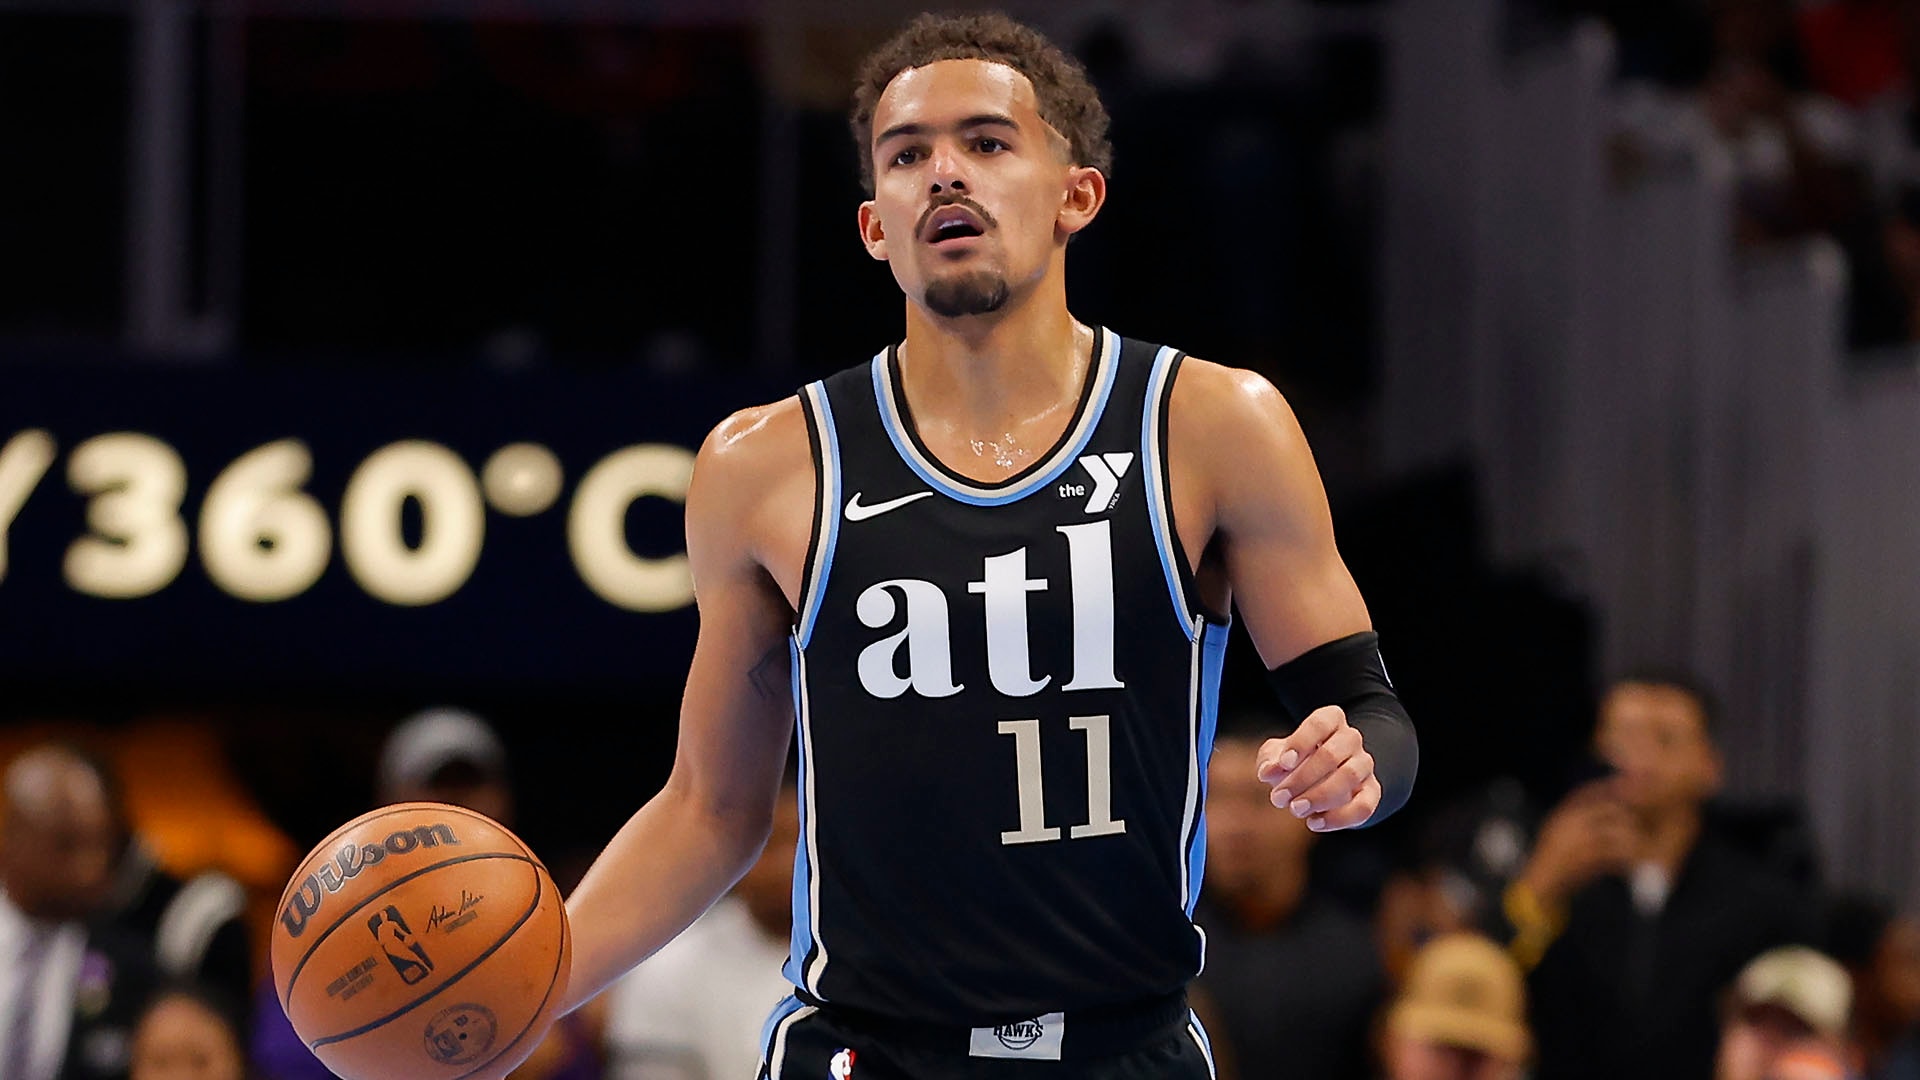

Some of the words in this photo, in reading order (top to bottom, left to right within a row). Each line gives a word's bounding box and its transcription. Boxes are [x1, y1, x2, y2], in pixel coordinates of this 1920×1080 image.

[1059, 484, 1085, 498] the
[856, 519, 1125, 698] atl
[998, 715, 1126, 845] 11
[281, 824, 460, 938] Wilson
